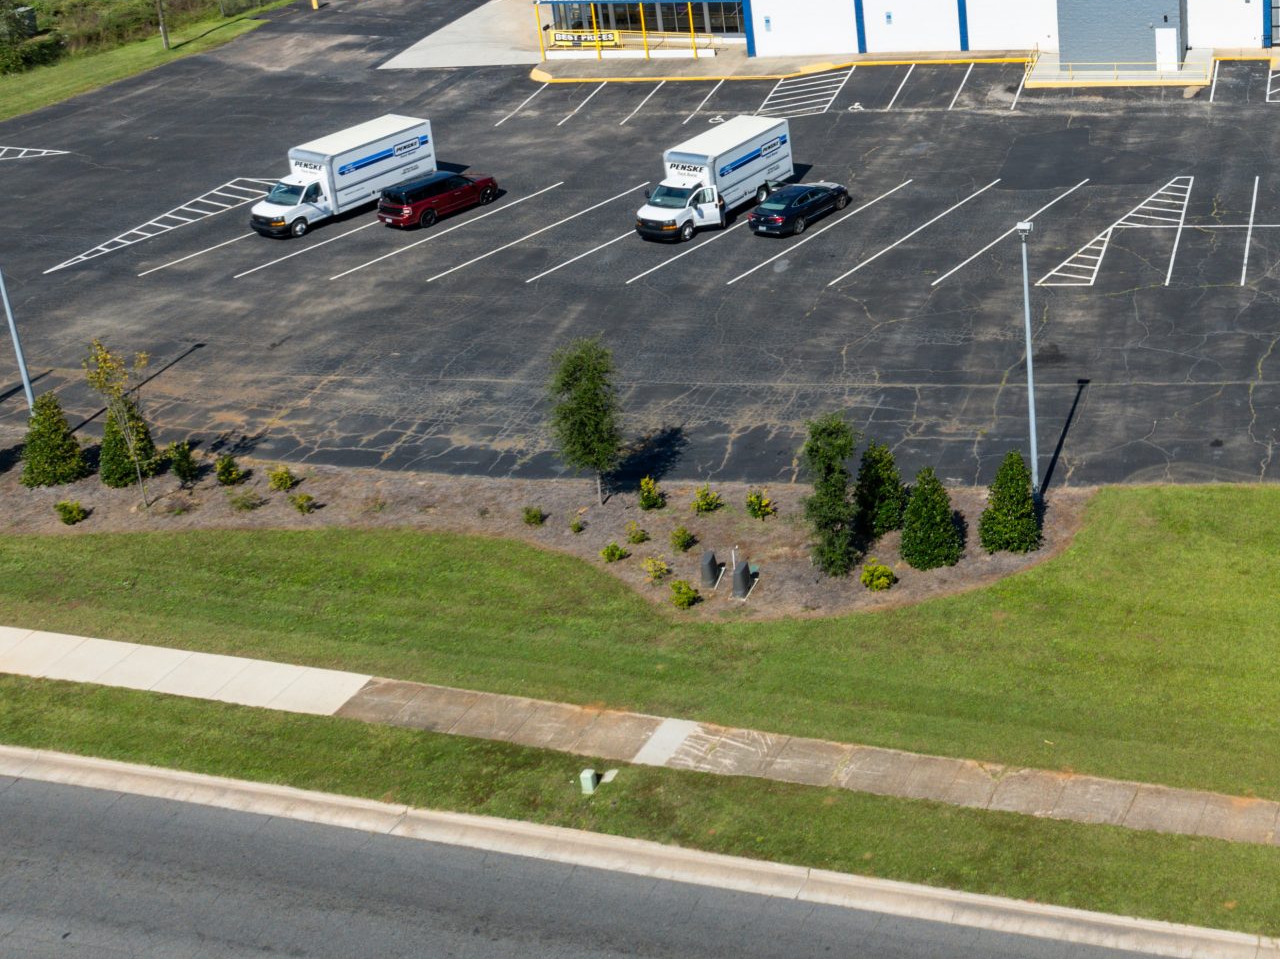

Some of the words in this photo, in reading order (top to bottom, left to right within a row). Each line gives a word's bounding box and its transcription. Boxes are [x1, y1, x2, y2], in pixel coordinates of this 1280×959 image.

[555, 33, 578, 41] BEST
[396, 141, 418, 152] PENSKE
[294, 160, 322, 171] PENSKE
[669, 163, 704, 173] PENSKE
